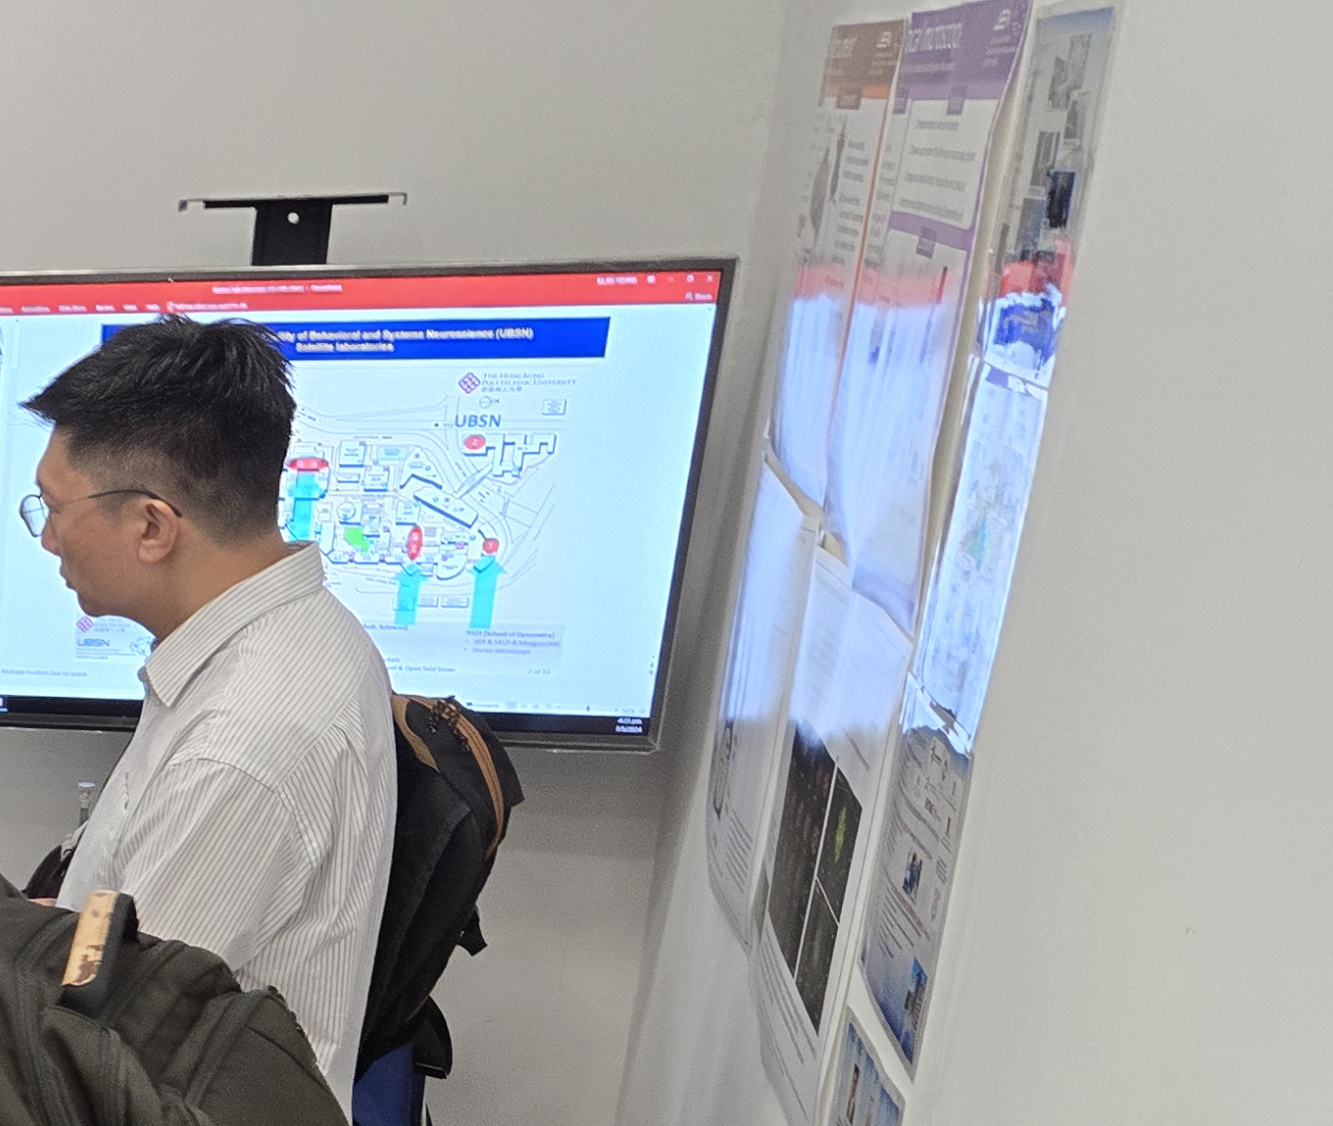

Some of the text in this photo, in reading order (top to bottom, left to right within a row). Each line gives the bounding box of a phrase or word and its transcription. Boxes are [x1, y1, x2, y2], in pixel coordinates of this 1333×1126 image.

[297, 330, 309, 341] of
[308, 330, 361, 341] Behavioral
[362, 330, 381, 341] and
[382, 329, 425, 342] Systems
[495, 327, 534, 341] (UBSN)
[295, 341, 395, 353] Satellite laboratories
[533, 378, 577, 386] UNIVERSITY
[454, 414, 502, 428] UBSN
[76, 638, 110, 647] UBSN
